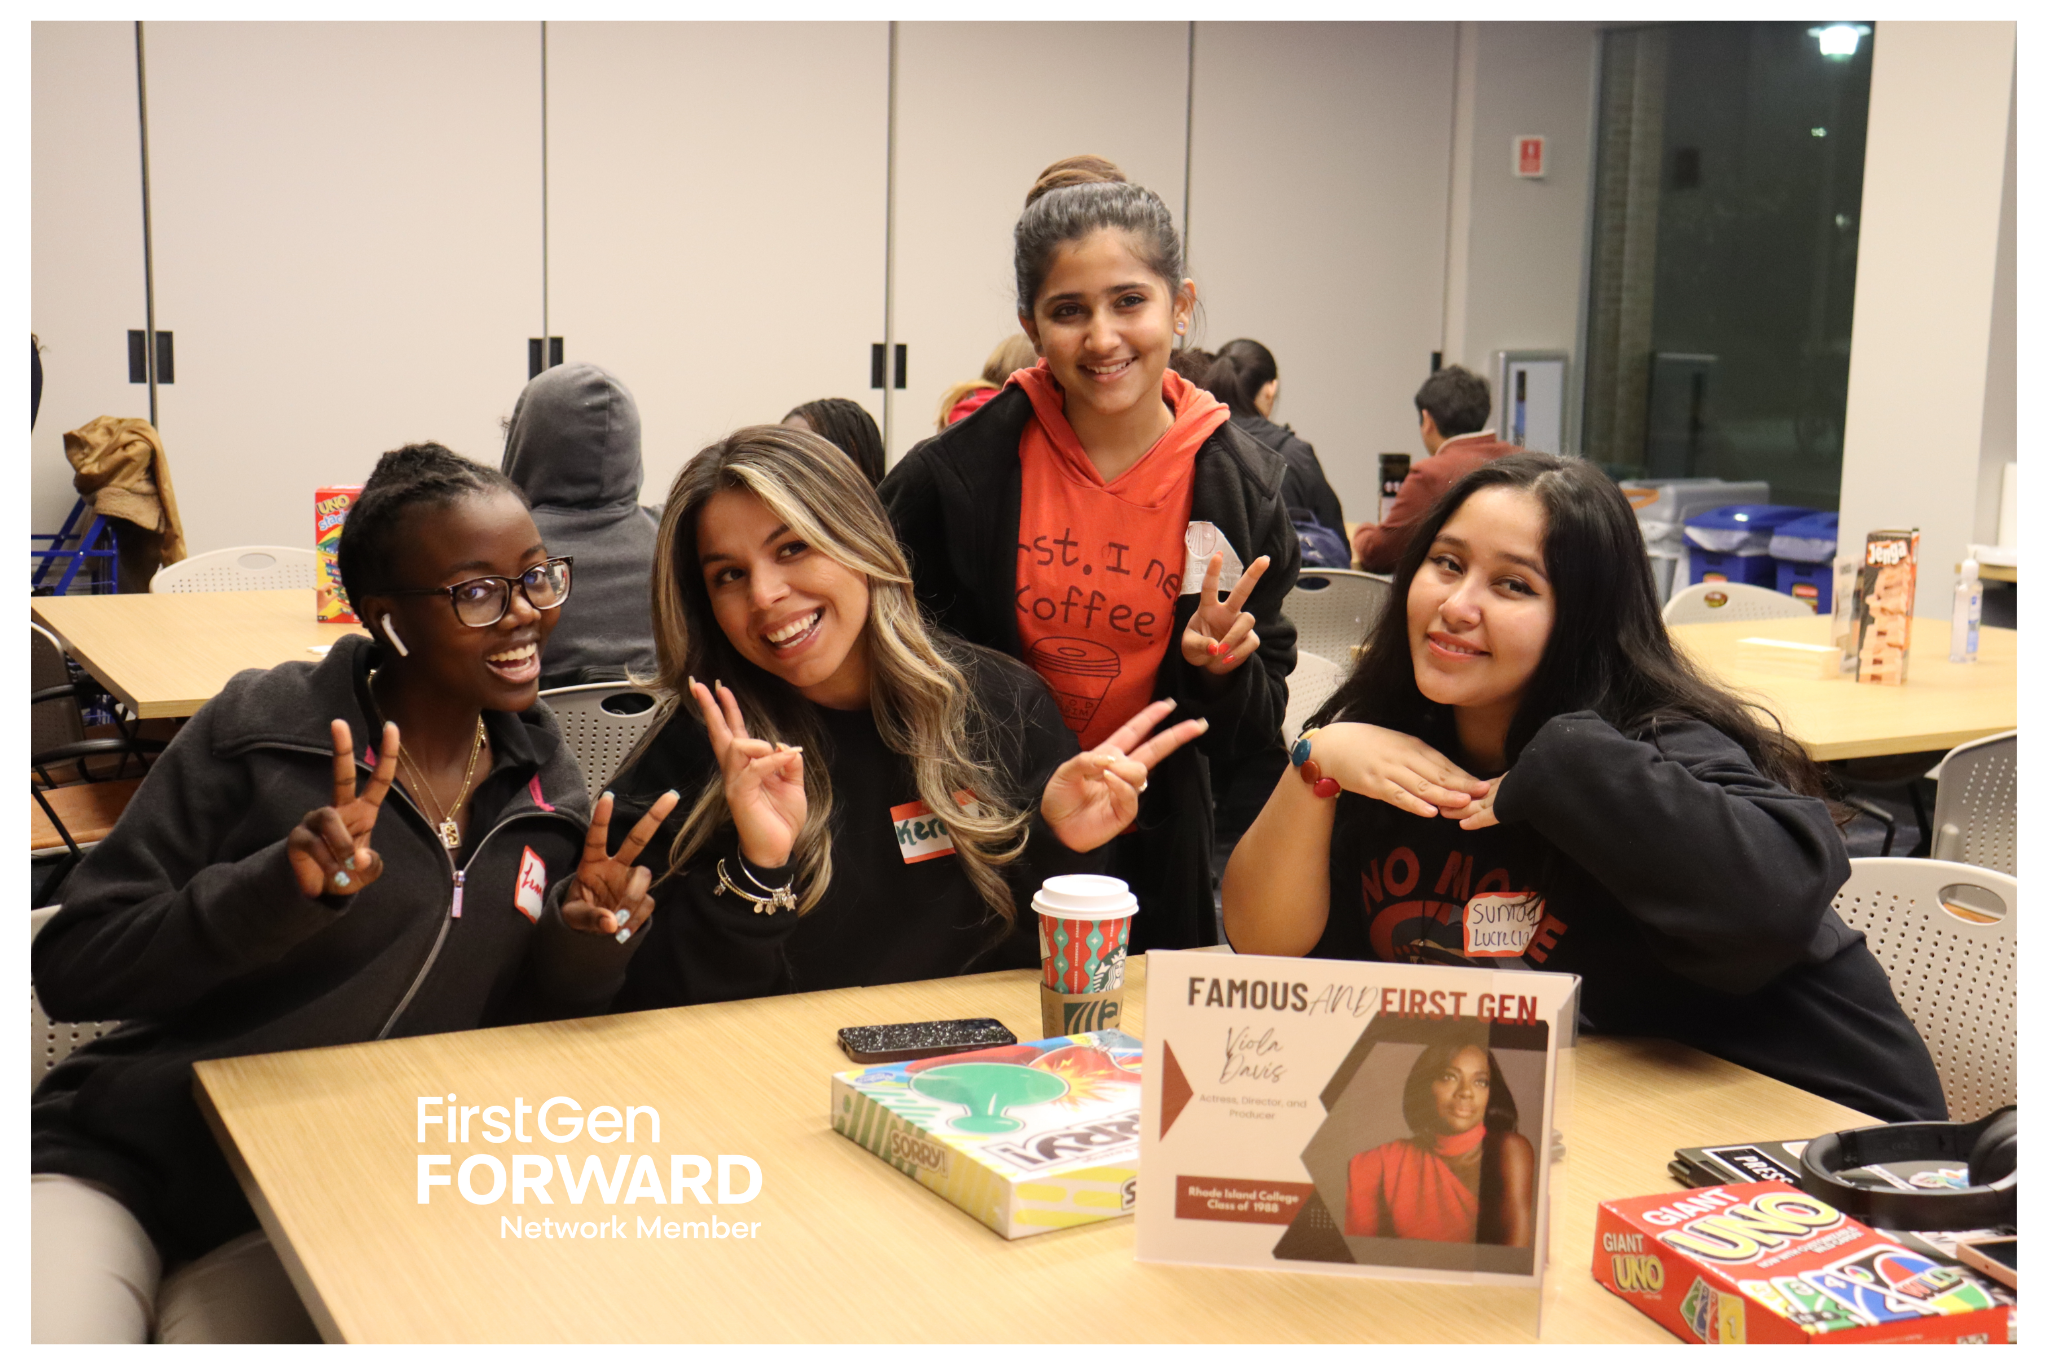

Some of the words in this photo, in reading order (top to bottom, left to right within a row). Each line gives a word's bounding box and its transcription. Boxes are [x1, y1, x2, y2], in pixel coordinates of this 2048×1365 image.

[316, 494, 350, 516] UNO
[1867, 540, 1908, 566] Jenga
[1106, 541, 1130, 575] I
[1143, 558, 1180, 600] ne
[1361, 846, 1421, 915] NO
[1434, 850, 1569, 963] MOE
[1187, 976, 1309, 1012] FAMOUS
[1308, 983, 1379, 1018] AND
[1380, 987, 1467, 1022] FIRST
[1477, 993, 1537, 1027] GEN
[1225, 1026, 1284, 1057] Viola
[1219, 1051, 1288, 1084] Davis
[1199, 1093, 1239, 1105] Actress,
[1241, 1095, 1284, 1108] Director,
[1286, 1098, 1307, 1109] and
[1229, 1108, 1276, 1121] Producer
[890, 1130, 948, 1176] SORRY!
[1188, 1186, 1222, 1199] Rhode
[1224, 1188, 1257, 1200] Island
[1258, 1191, 1300, 1205] College
[1207, 1199, 1236, 1211] Class
[1237, 1200, 1249, 1211] of
[1253, 1202, 1280, 1213] 1988
[1641, 1187, 1740, 1226] GIANT
[1602, 1232, 1645, 1253] GIANT
[1659, 1193, 1844, 1263] UNO
[1611, 1254, 1665, 1293] UNO
[1895, 1266, 1964, 1300] WILD
